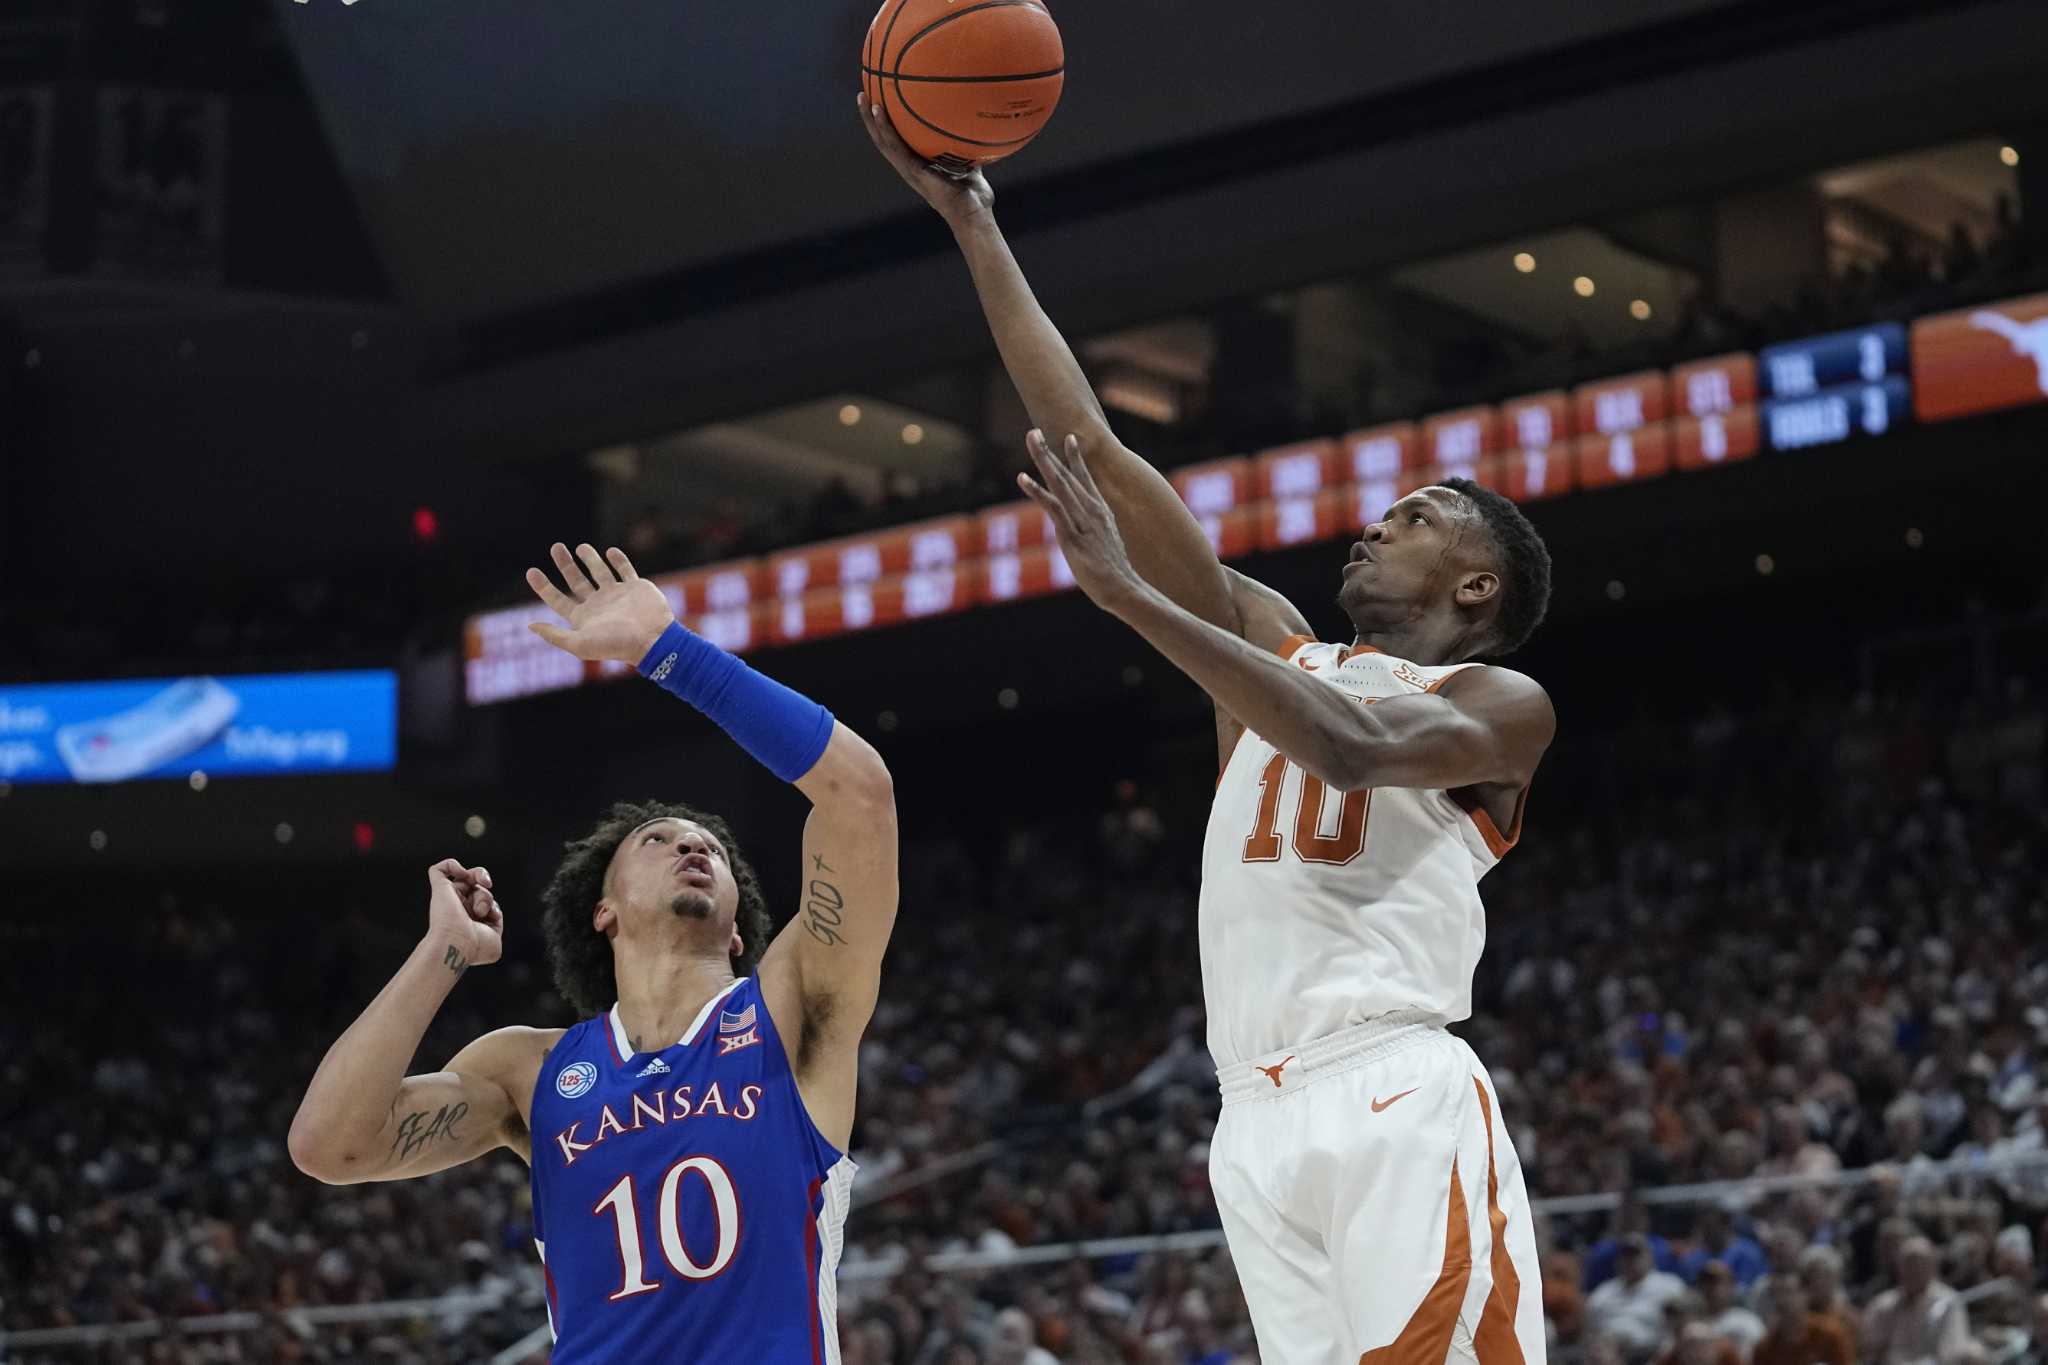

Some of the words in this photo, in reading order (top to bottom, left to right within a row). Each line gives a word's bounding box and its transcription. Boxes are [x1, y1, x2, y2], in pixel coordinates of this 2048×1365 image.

[1242, 750, 1374, 866] 10
[561, 1071, 582, 1087] 125
[635, 1064, 671, 1079] adidas
[387, 1102, 469, 1161] FEAR
[556, 1081, 763, 1166] KANSAS
[592, 1154, 745, 1302] 10
